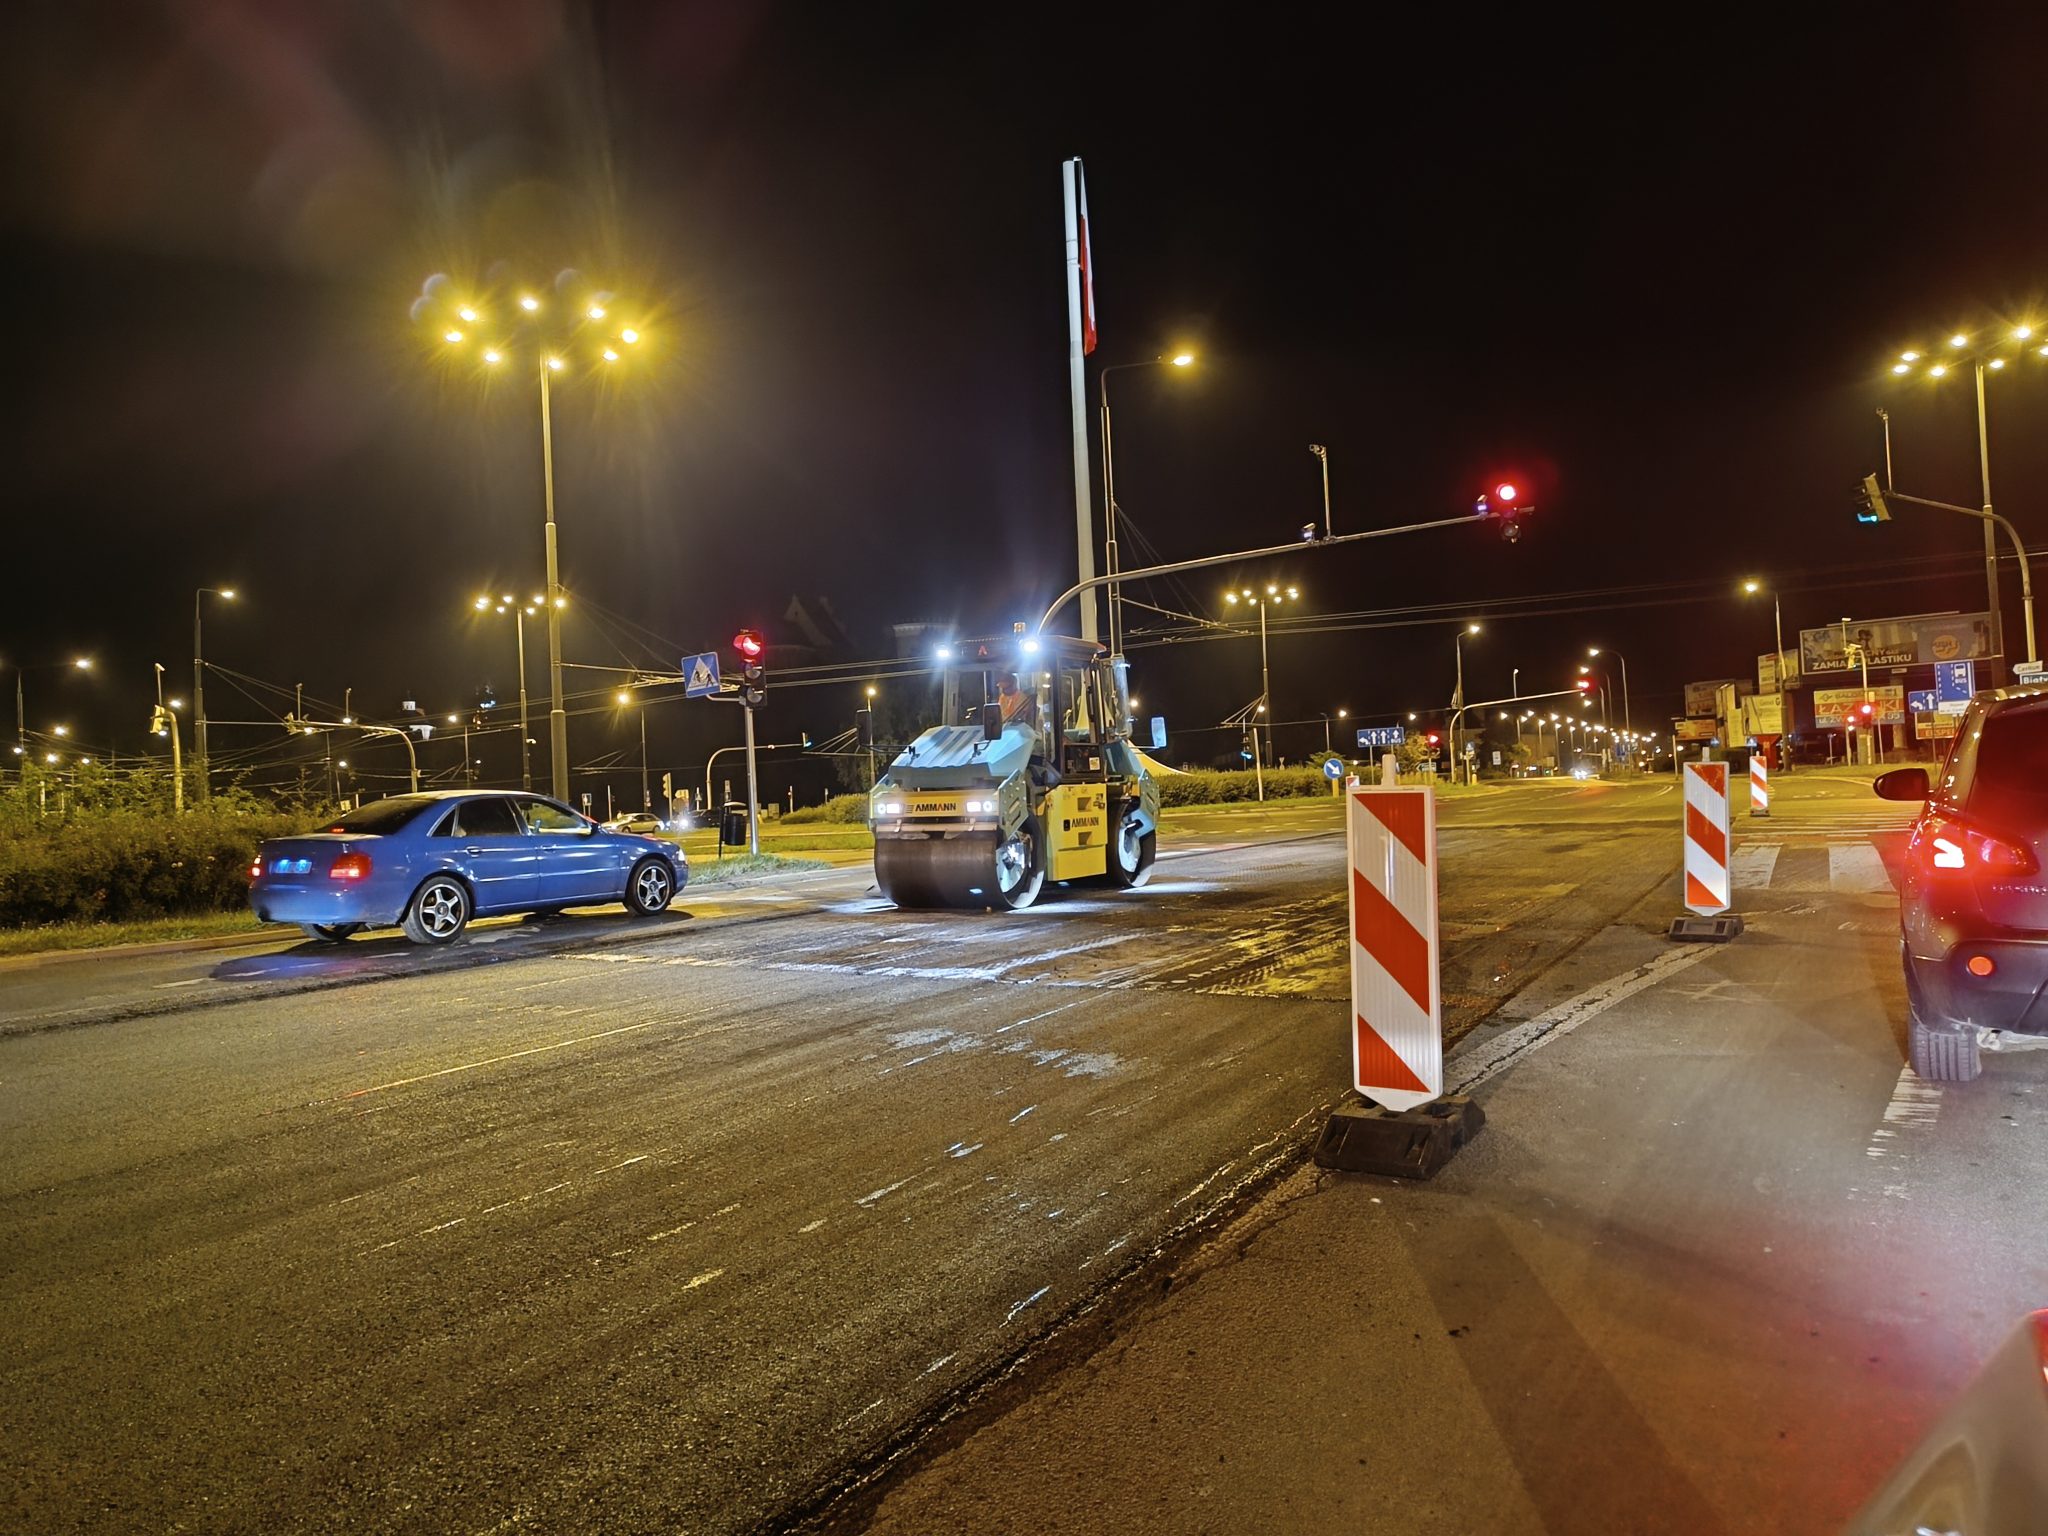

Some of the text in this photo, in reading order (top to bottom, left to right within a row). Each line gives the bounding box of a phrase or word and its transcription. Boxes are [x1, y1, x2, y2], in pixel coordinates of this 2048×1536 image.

[1813, 654, 1912, 670] ZAMIA LASTIKU
[1819, 700, 1899, 715] ŁAZKI
[915, 802, 956, 812] AMMANN
[1071, 817, 1099, 828] AMMANN
